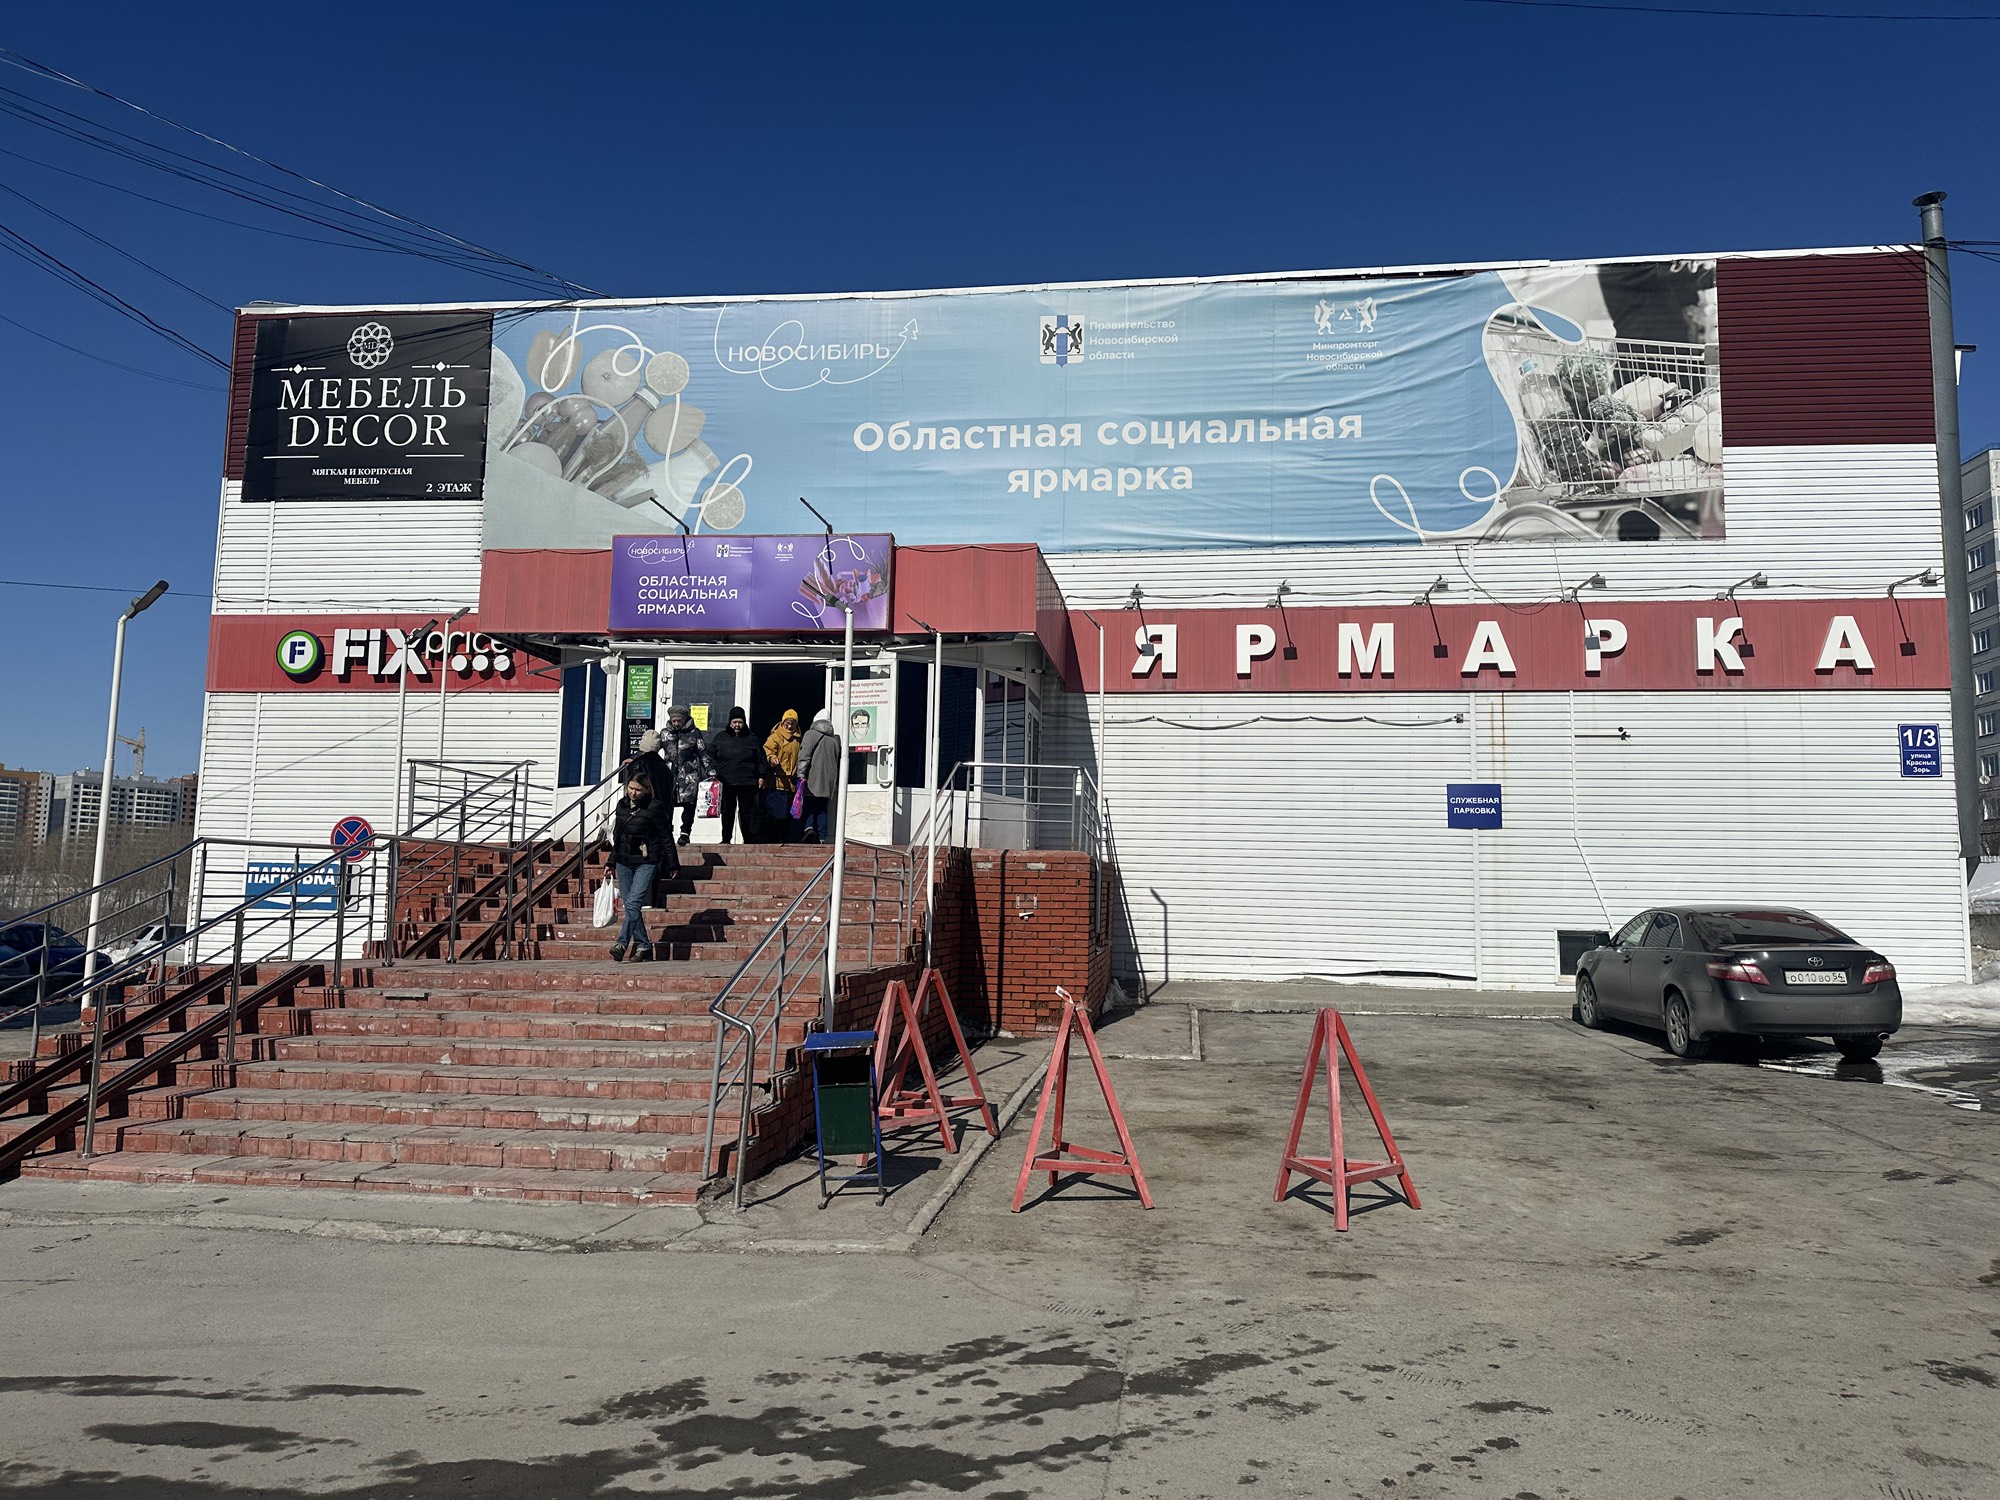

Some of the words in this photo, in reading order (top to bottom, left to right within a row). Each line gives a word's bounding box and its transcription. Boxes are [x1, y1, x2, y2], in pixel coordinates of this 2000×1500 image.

[1089, 320, 1176, 332] Правительство
[1089, 334, 1179, 346] Новосибирской
[1312, 342, 1379, 350] Минпромторг
[728, 343, 890, 361] НОВОСИБИРЬ
[1088, 351, 1135, 360] области
[1306, 350, 1383, 361] Новосибирской
[1325, 362, 1365, 371] области
[277, 377, 466, 410] МЕБЕЛЬ
[287, 414, 449, 447] DECOR
[853, 421, 1082, 453] Областная
[1097, 414, 1364, 450] социальная
[311, 468, 348, 476] МЯГКАЯ
[350, 468, 357, 476] И
[358, 467, 413, 477] КОРПУСНАЯ
[344, 478, 380, 486] МЕБЕЛЬ
[426, 483, 433, 493] 2
[437, 482, 472, 493] ЭТАЖ
[1007, 466, 1194, 499] ярмарка
[639, 576, 728, 587] ОБЛАСТНАЯ
[638, 589, 738, 600] СОЦИАЛЬНАЯ
[637, 604, 706, 615] ЯРМАРКА
[1131, 615, 1875, 678] ЯРМАРКА
[289, 641, 306, 664] F
[1903, 728, 1937, 747] 1/3
